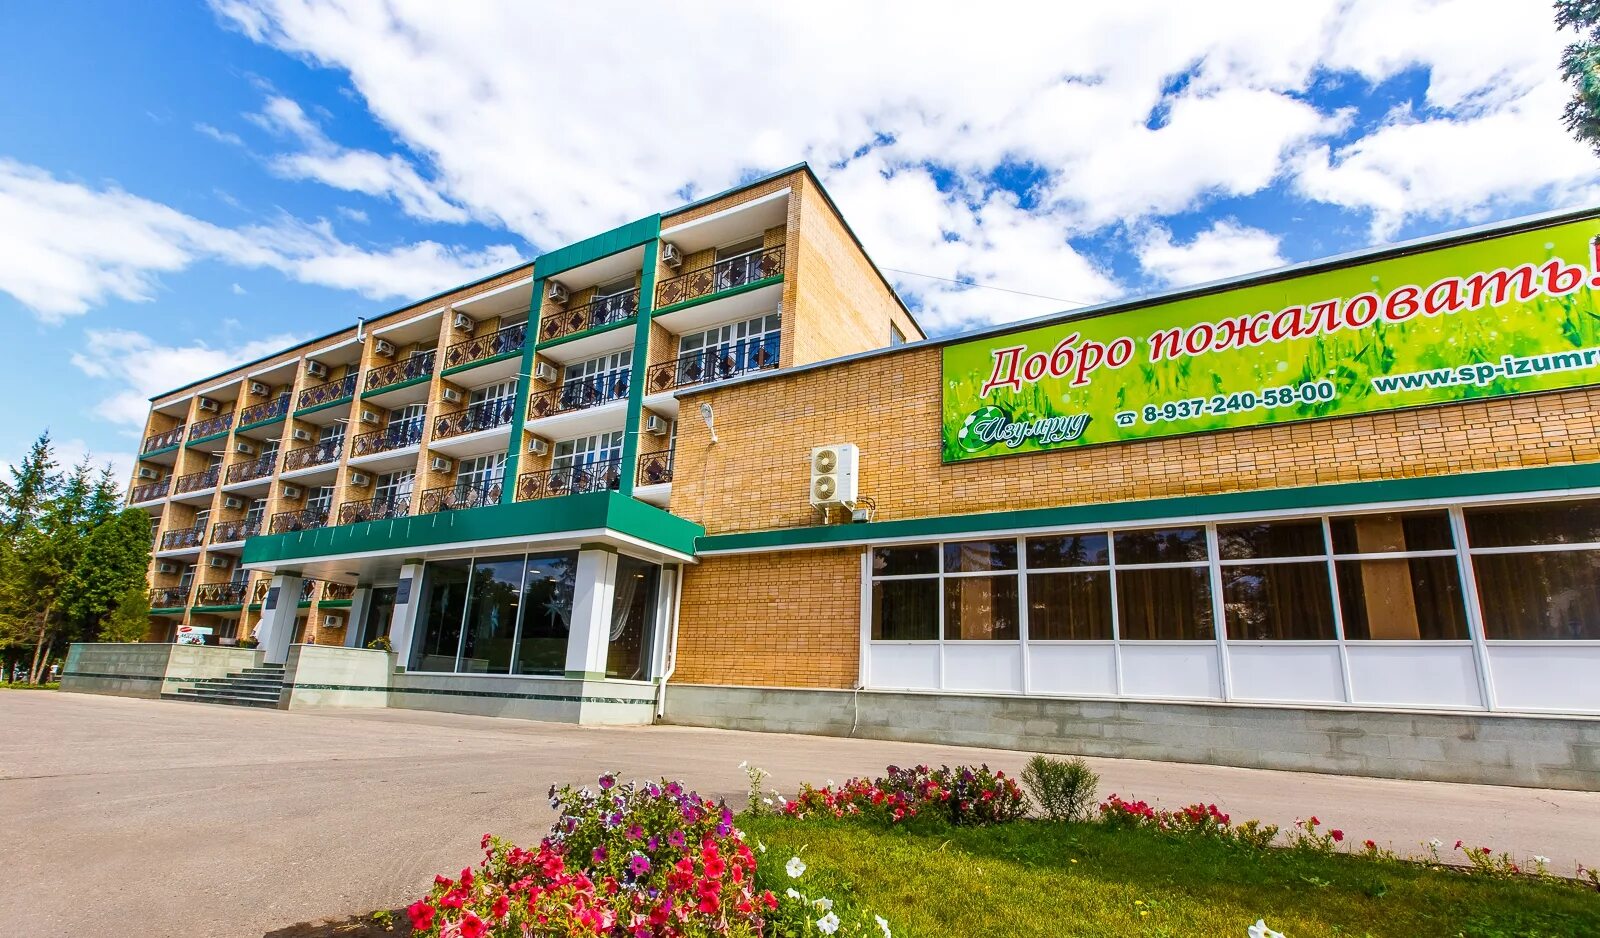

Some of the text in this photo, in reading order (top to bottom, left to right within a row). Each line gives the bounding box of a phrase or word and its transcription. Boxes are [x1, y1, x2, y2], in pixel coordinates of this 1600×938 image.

[982, 334, 1133, 396] Добро
[1374, 349, 1600, 392] www.sp-izumr
[1143, 382, 1334, 422] 8-937-240-58-00
[975, 413, 1091, 448] Изумруд
